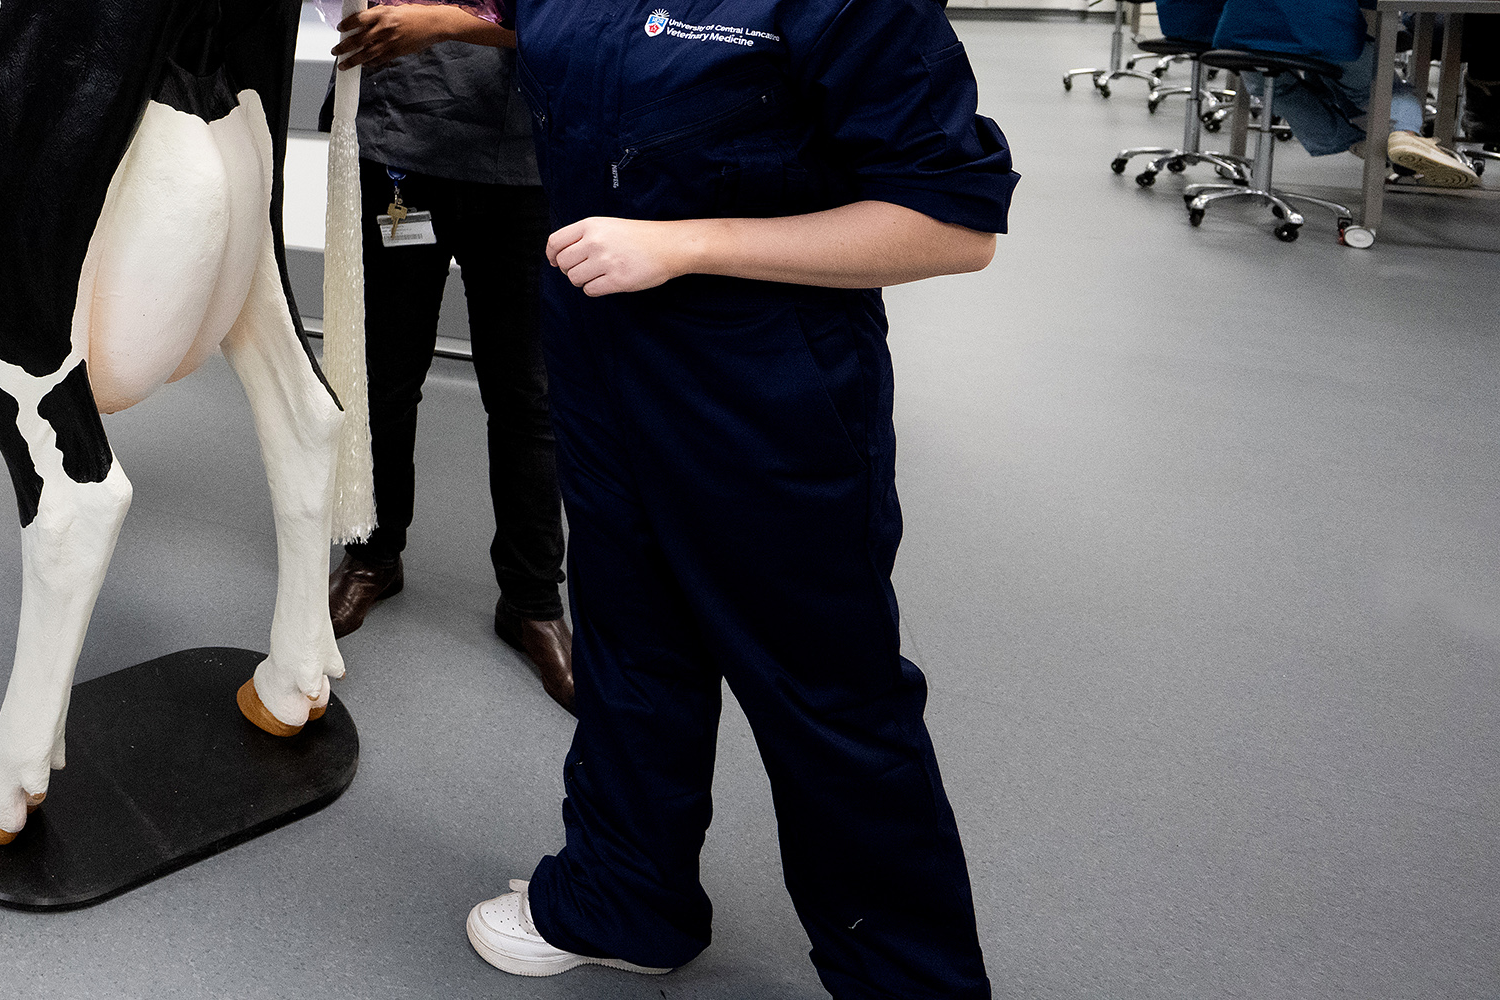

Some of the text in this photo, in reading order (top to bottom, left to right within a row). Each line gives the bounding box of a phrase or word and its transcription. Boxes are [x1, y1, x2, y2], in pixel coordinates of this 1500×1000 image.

[667, 27, 754, 47] Veterinary Medicine
[714, 24, 744, 35] Central
